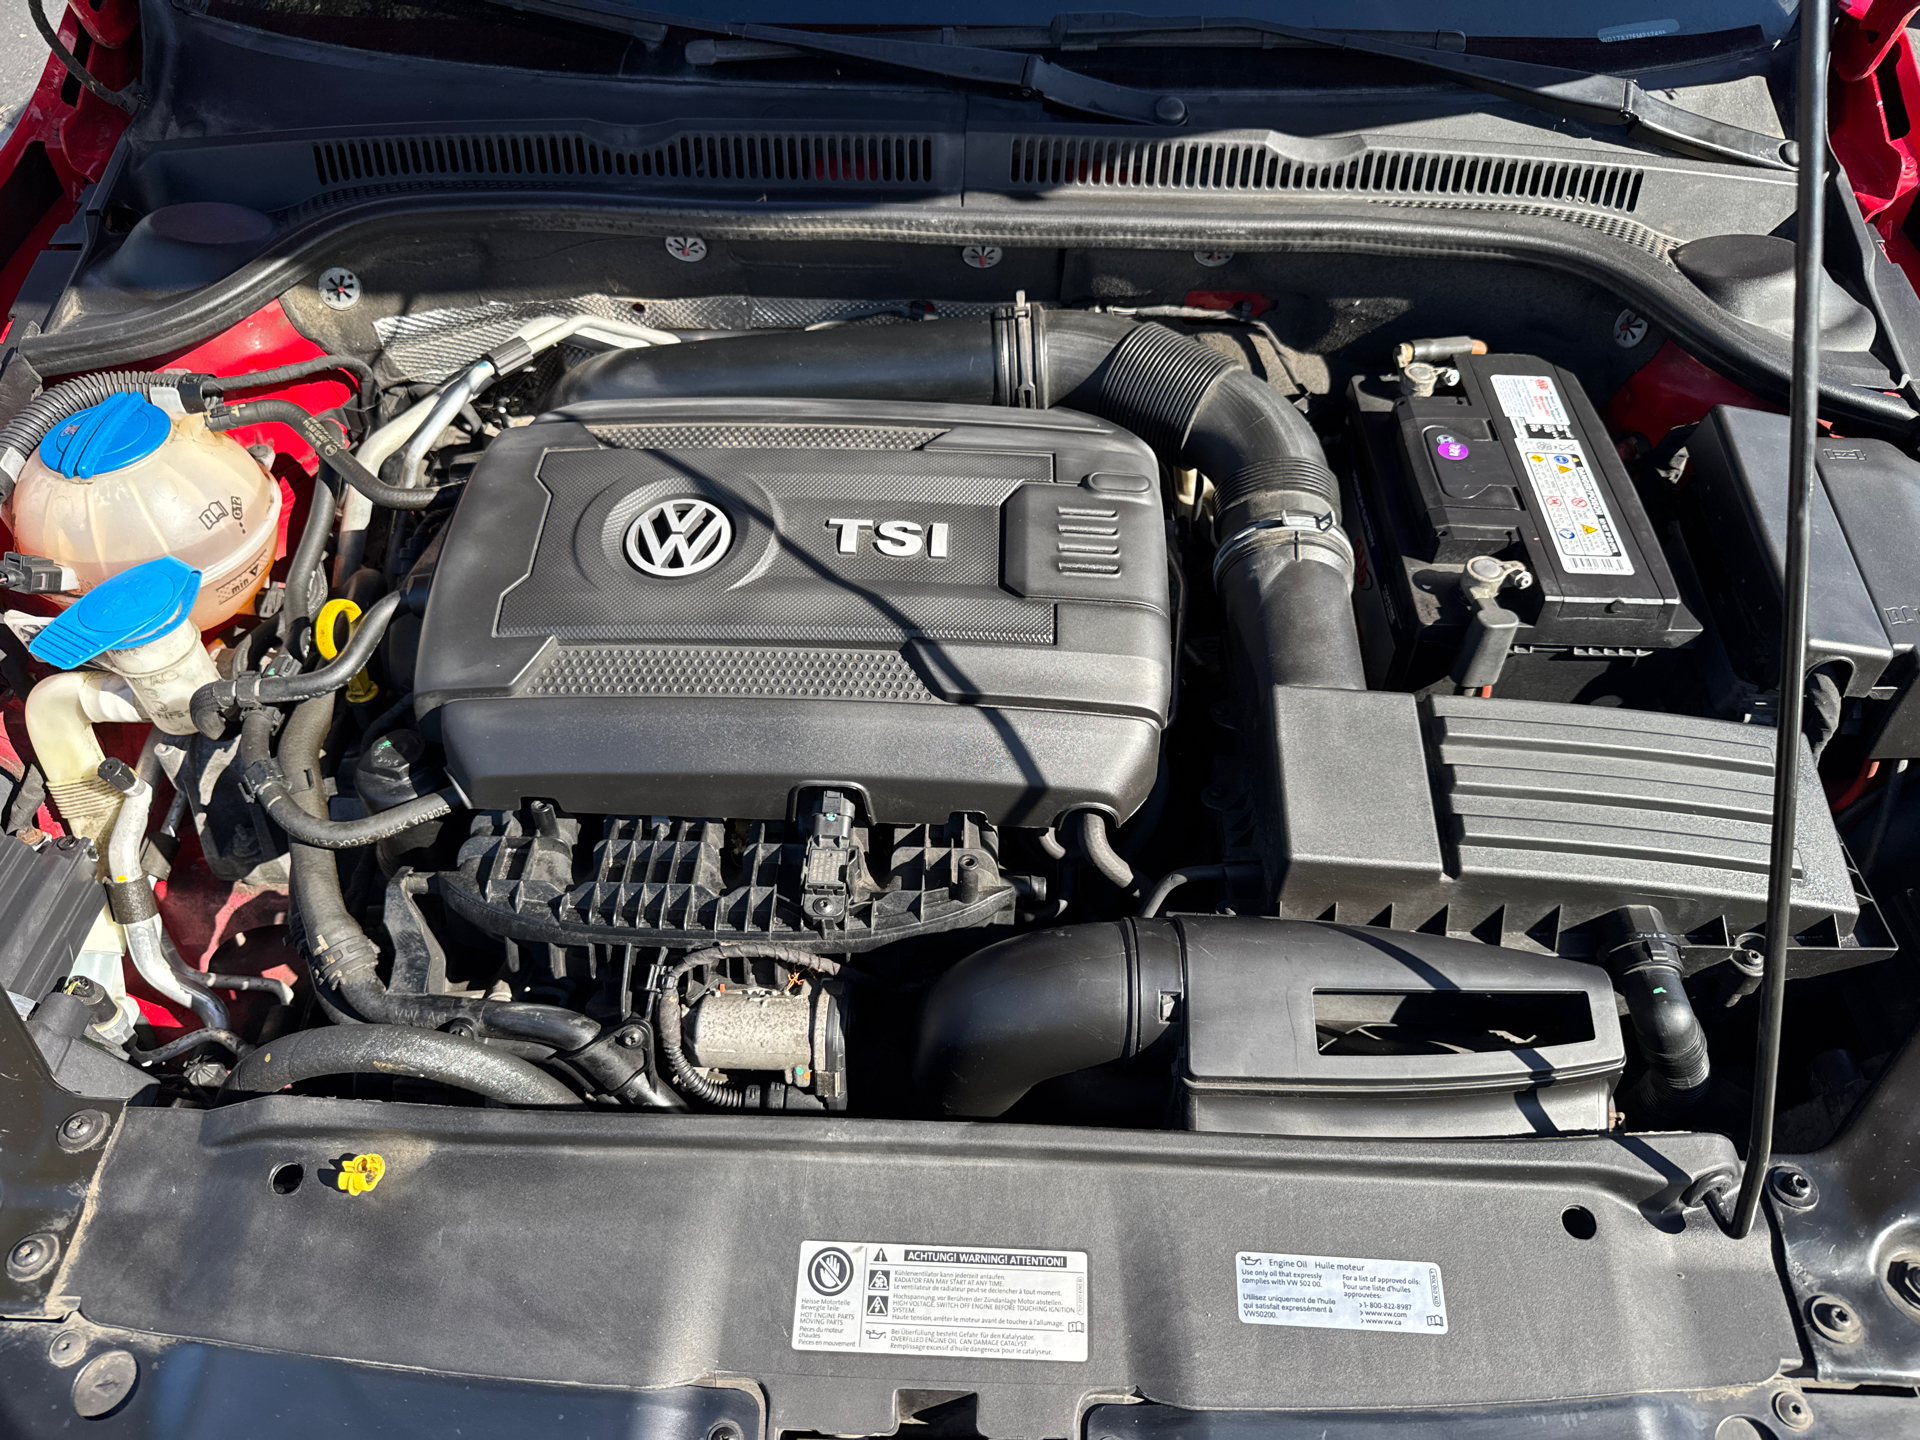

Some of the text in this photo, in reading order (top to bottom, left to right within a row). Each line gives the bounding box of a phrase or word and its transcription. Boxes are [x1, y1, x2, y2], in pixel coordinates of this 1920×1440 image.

[826, 518, 949, 559] TSI
[231, 577, 249, 594] min
[410, 805, 452, 825] S20841A
[908, 1252, 1064, 1266] ACHTUNG! WARNING! ATTENTION!
[1269, 1259, 1294, 1268] Engine
[1268, 1295, 1306, 1304] uniquement
[1244, 1310, 1278, 1318] VW50200.
[1281, 1304, 1327, 1313] expressément
